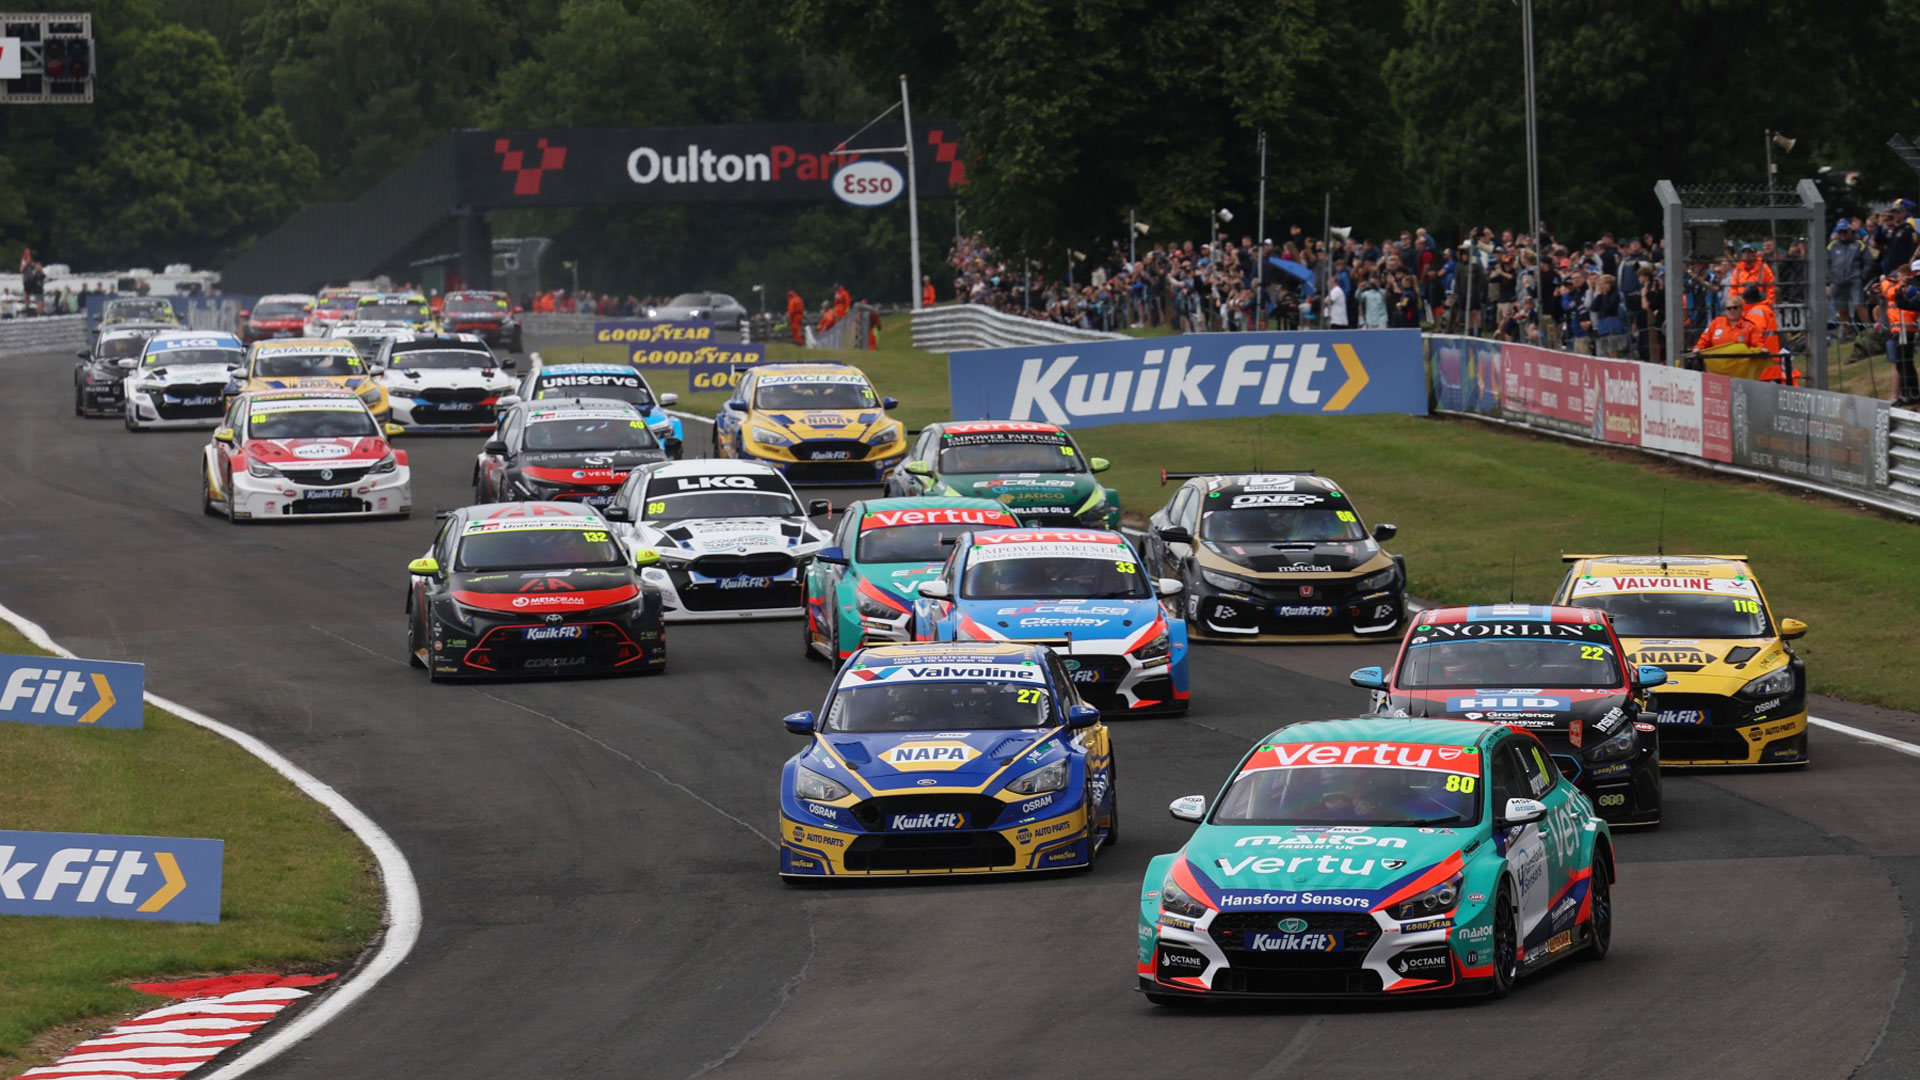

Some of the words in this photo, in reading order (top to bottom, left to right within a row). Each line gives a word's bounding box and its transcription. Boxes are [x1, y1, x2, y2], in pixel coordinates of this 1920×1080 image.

[947, 433, 1004, 443] EMPOWER
[1008, 433, 1065, 443] PARTNERS
[677, 476, 758, 490] LKQ
[648, 502, 666, 514] 99
[583, 532, 608, 542] 132
[1115, 561, 1136, 574] 33
[1612, 577, 1714, 591] VALVOLINE
[1732, 600, 1759, 613] 116
[1431, 623, 1584, 637] NORLIN
[1580, 646, 1604, 661] 22
[1641, 652, 1700, 663] NAPA
[907, 667, 1034, 680] Valvoline
[1017, 688, 1041, 704] 27
[1460, 698, 1559, 708] HID
[1754, 699, 1780, 714] OSRAM
[896, 747, 964, 761] NAPA
[1446, 774, 1475, 794] 80
[1022, 795, 1053, 813] OSRAM
[809, 803, 836, 820] OSRAM
[1035, 826, 1052, 838] AUTO
[1052, 821, 1070, 834] PARTS
[806, 832, 823, 844] AUTO
[823, 836, 845, 847] PARTS
[1221, 893, 1297, 907] Hansford
[1301, 892, 1370, 908] Sensors
[1406, 919, 1451, 931] GOODYEAR
[1170, 954, 1201, 966] OCTANE
[1409, 956, 1446, 967] OCTANE
